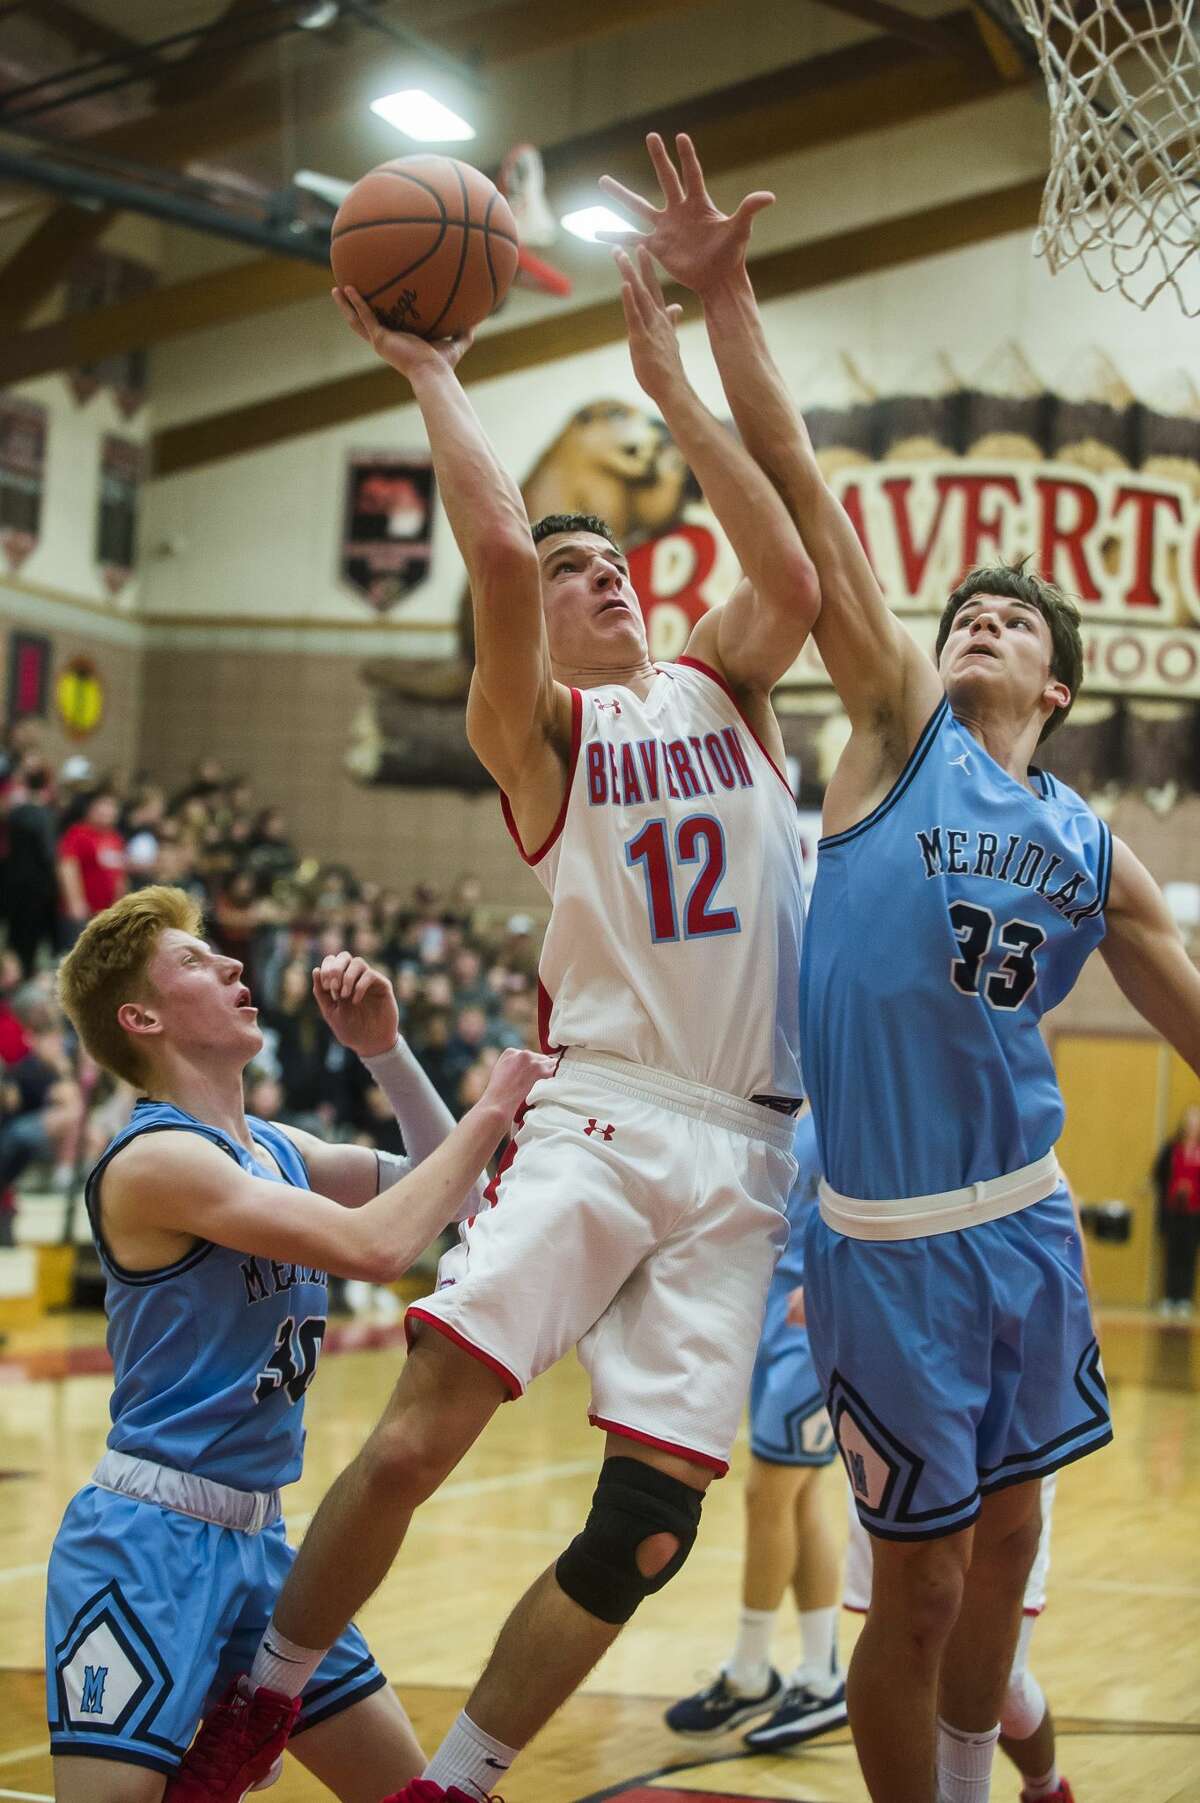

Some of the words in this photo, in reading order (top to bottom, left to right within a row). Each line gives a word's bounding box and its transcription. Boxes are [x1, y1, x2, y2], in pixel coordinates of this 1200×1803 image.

[625, 474, 1200, 662] BVERT
[586, 725, 754, 806] BEAVERTON
[624, 813, 742, 944] 12
[947, 899, 1048, 1012] 33
[252, 1316, 328, 1405] 30
[80, 1664, 109, 1714] M
